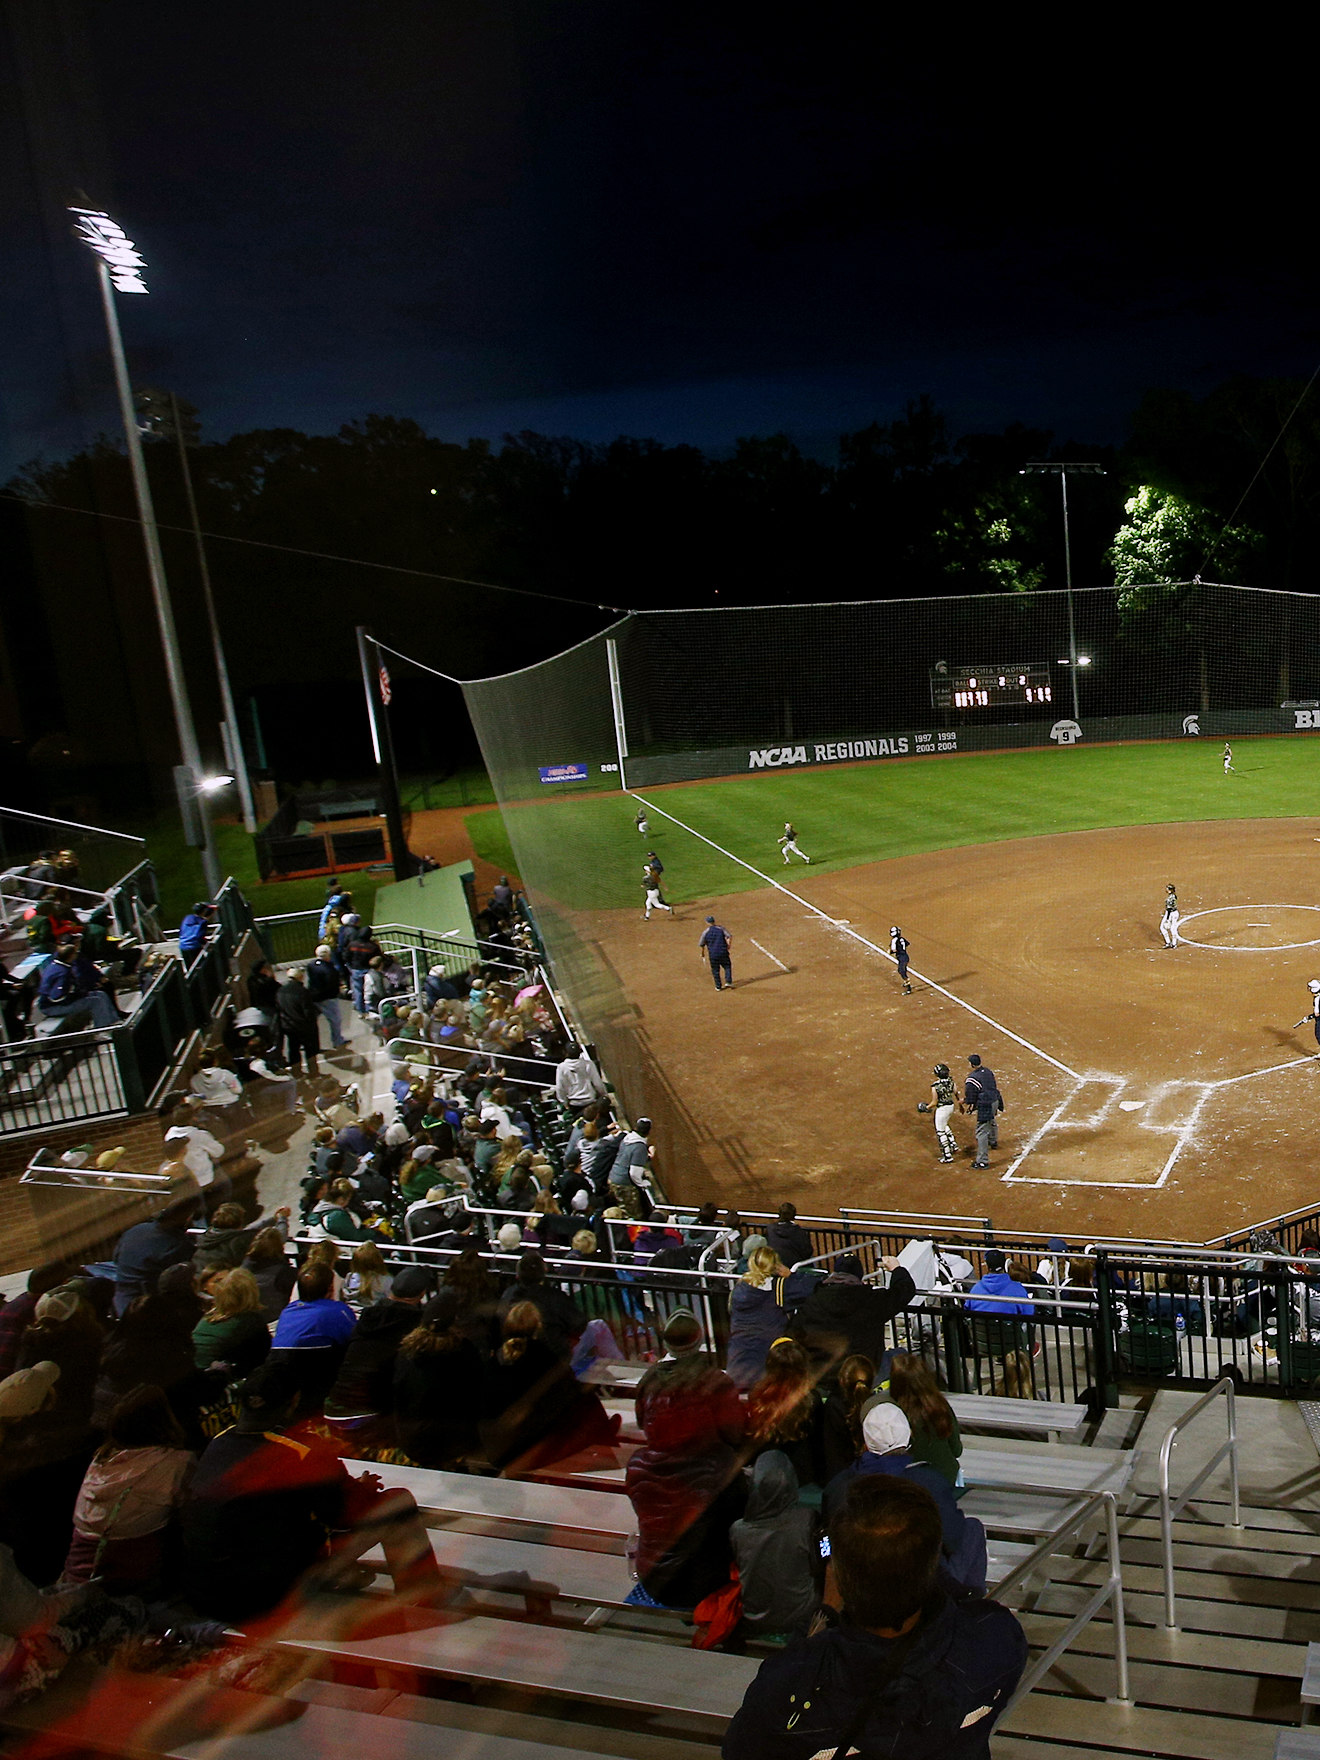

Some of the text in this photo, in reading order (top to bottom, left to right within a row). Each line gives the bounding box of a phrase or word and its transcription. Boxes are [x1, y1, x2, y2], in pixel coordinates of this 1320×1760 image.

[960, 666, 1031, 676] SECCHIA STADIUM
[914, 732, 956, 743] 1997 1999
[1062, 731, 1070, 742] 9
[748, 737, 909, 769] NCAA REGIONALS
[916, 742, 957, 753] 2003 2004
[600, 763, 618, 773] 200
